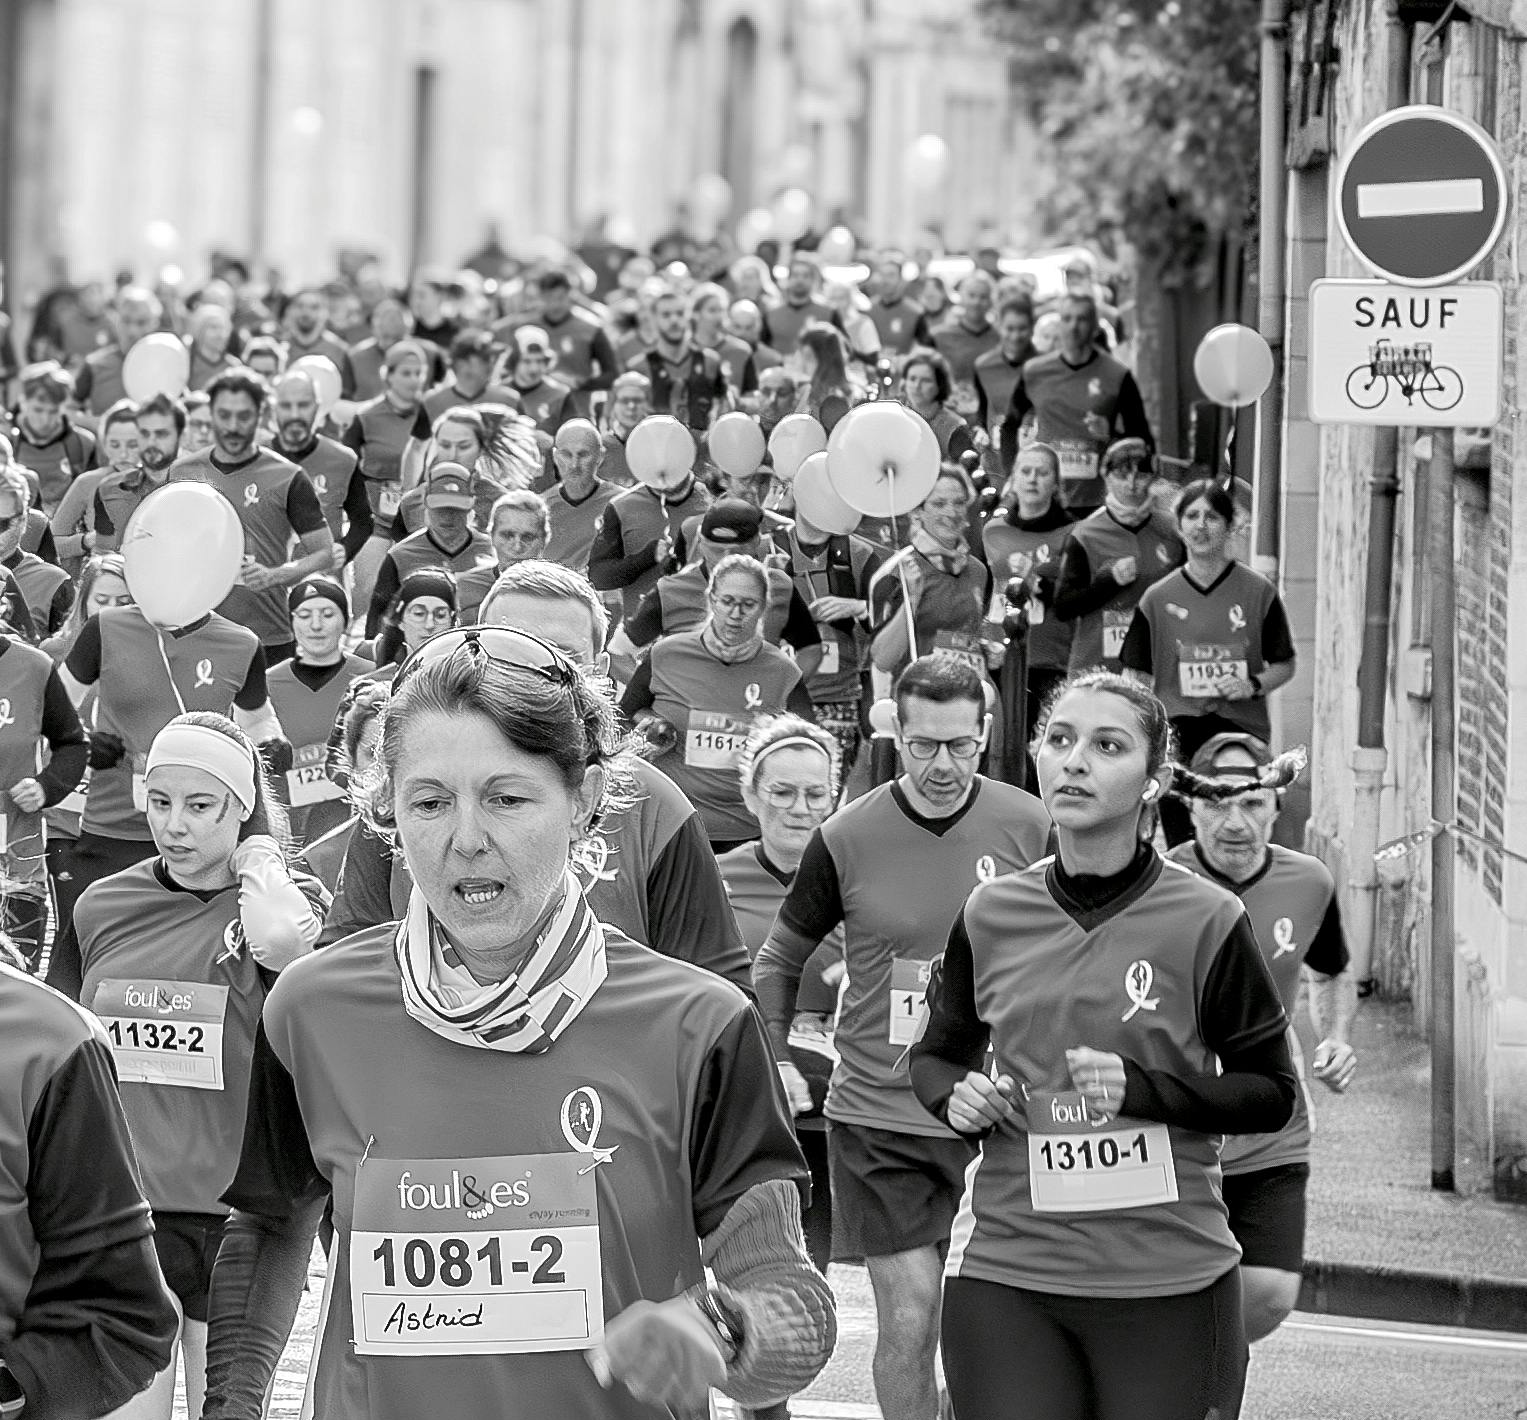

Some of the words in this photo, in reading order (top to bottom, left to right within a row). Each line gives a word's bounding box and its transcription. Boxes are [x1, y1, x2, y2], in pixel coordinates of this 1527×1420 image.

[1354, 296, 1458, 329] SAUF
[108, 1020, 204, 1053] 1132-2
[1040, 1133, 1149, 1170] 1310-1
[397, 1169, 532, 1220] foul&es
[373, 1235, 566, 1288] 1081-2
[383, 1302, 483, 1335] Astrid
